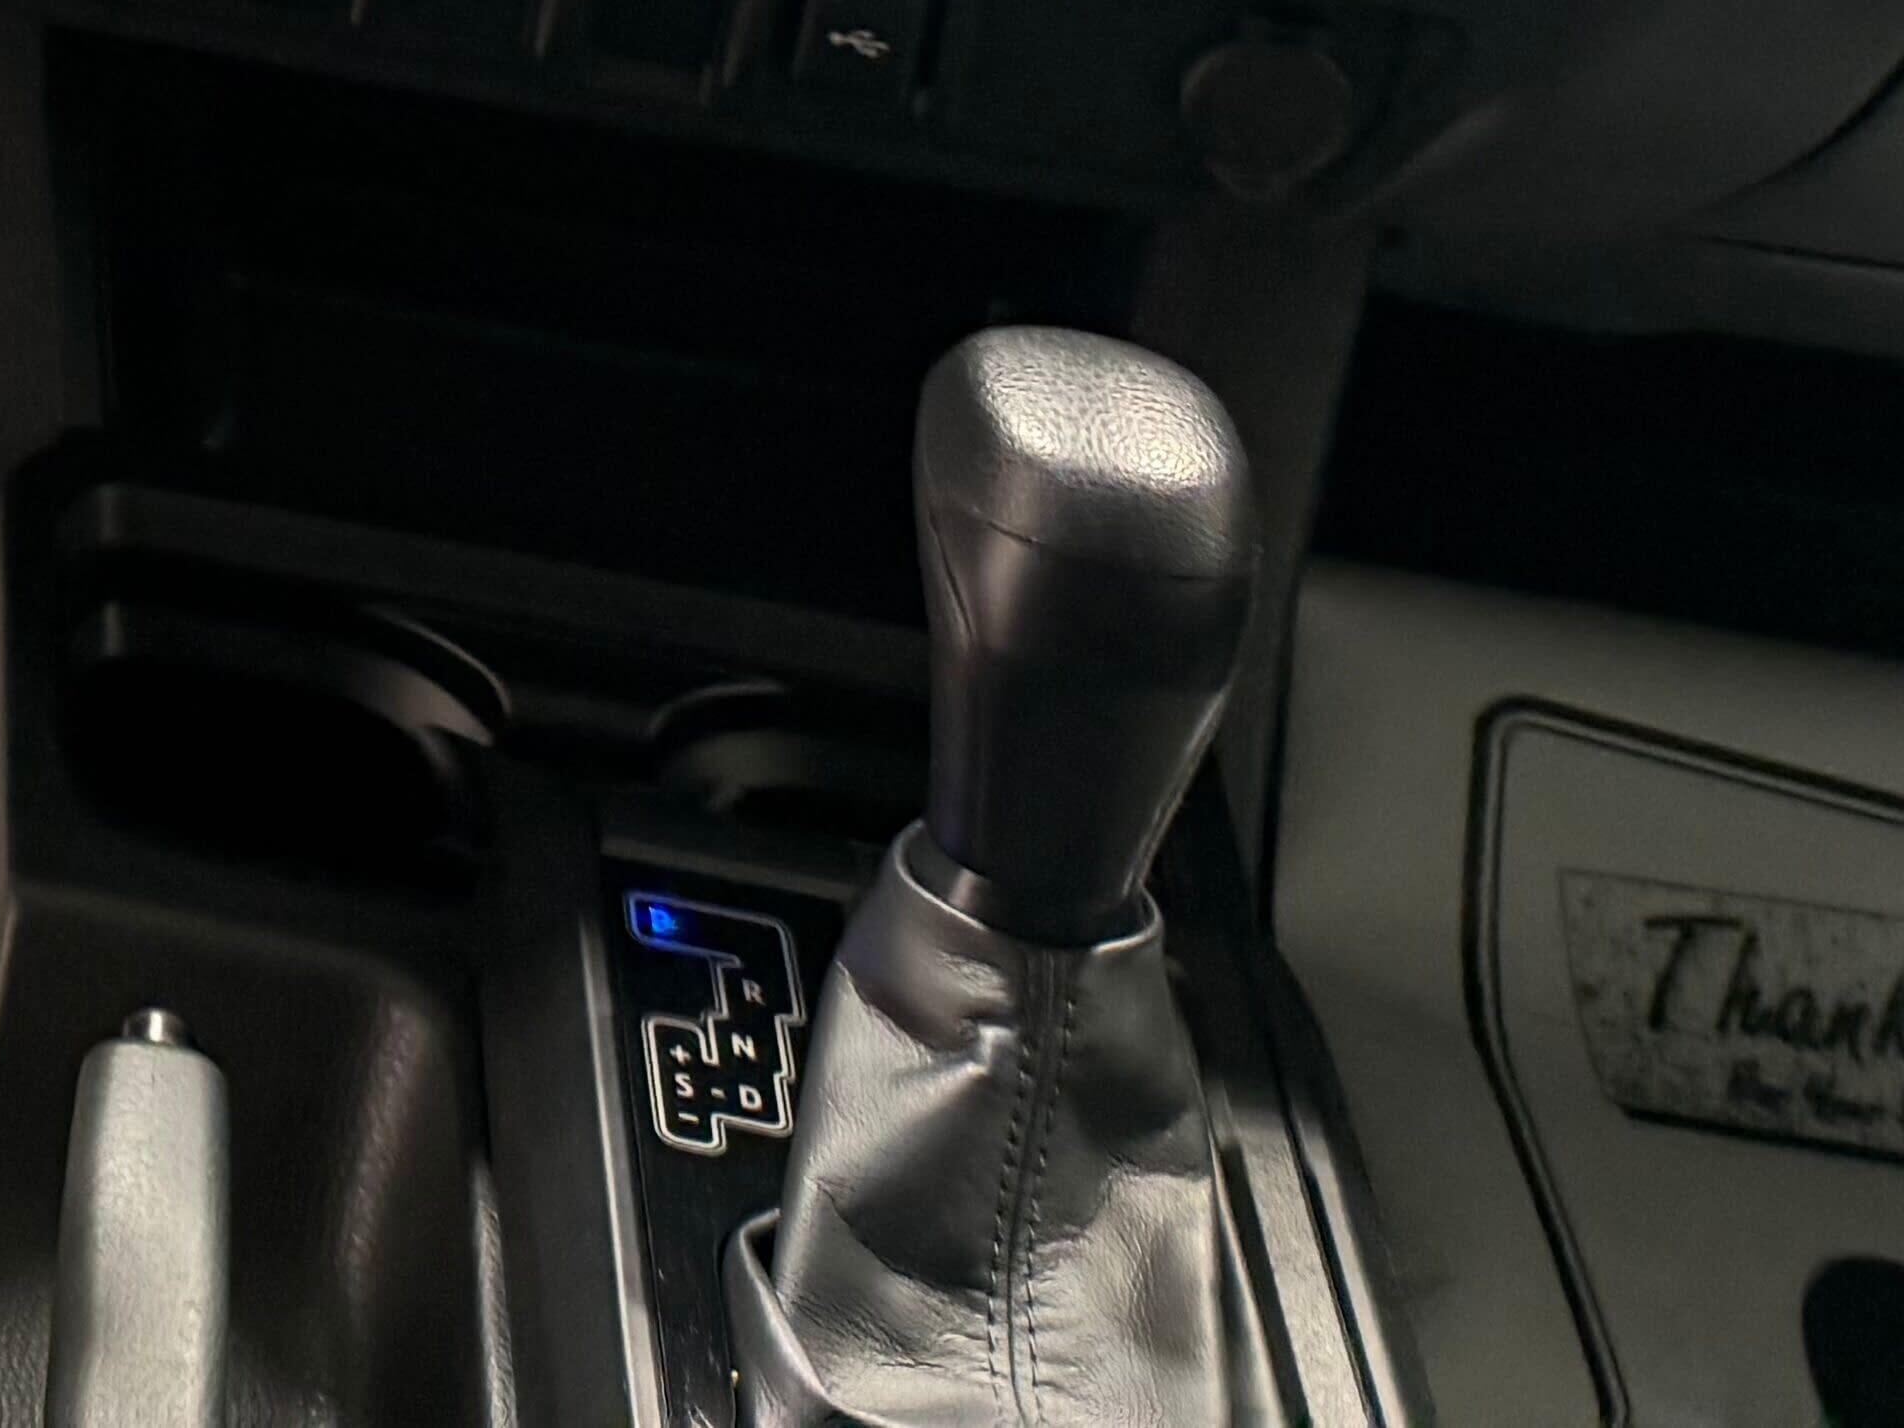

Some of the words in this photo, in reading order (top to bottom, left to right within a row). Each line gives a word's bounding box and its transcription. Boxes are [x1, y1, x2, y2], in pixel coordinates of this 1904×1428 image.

[743, 979, 764, 1006] R
[731, 1033, 755, 1060] N
[675, 1072, 693, 1099] S
[737, 1084, 763, 1110] D
